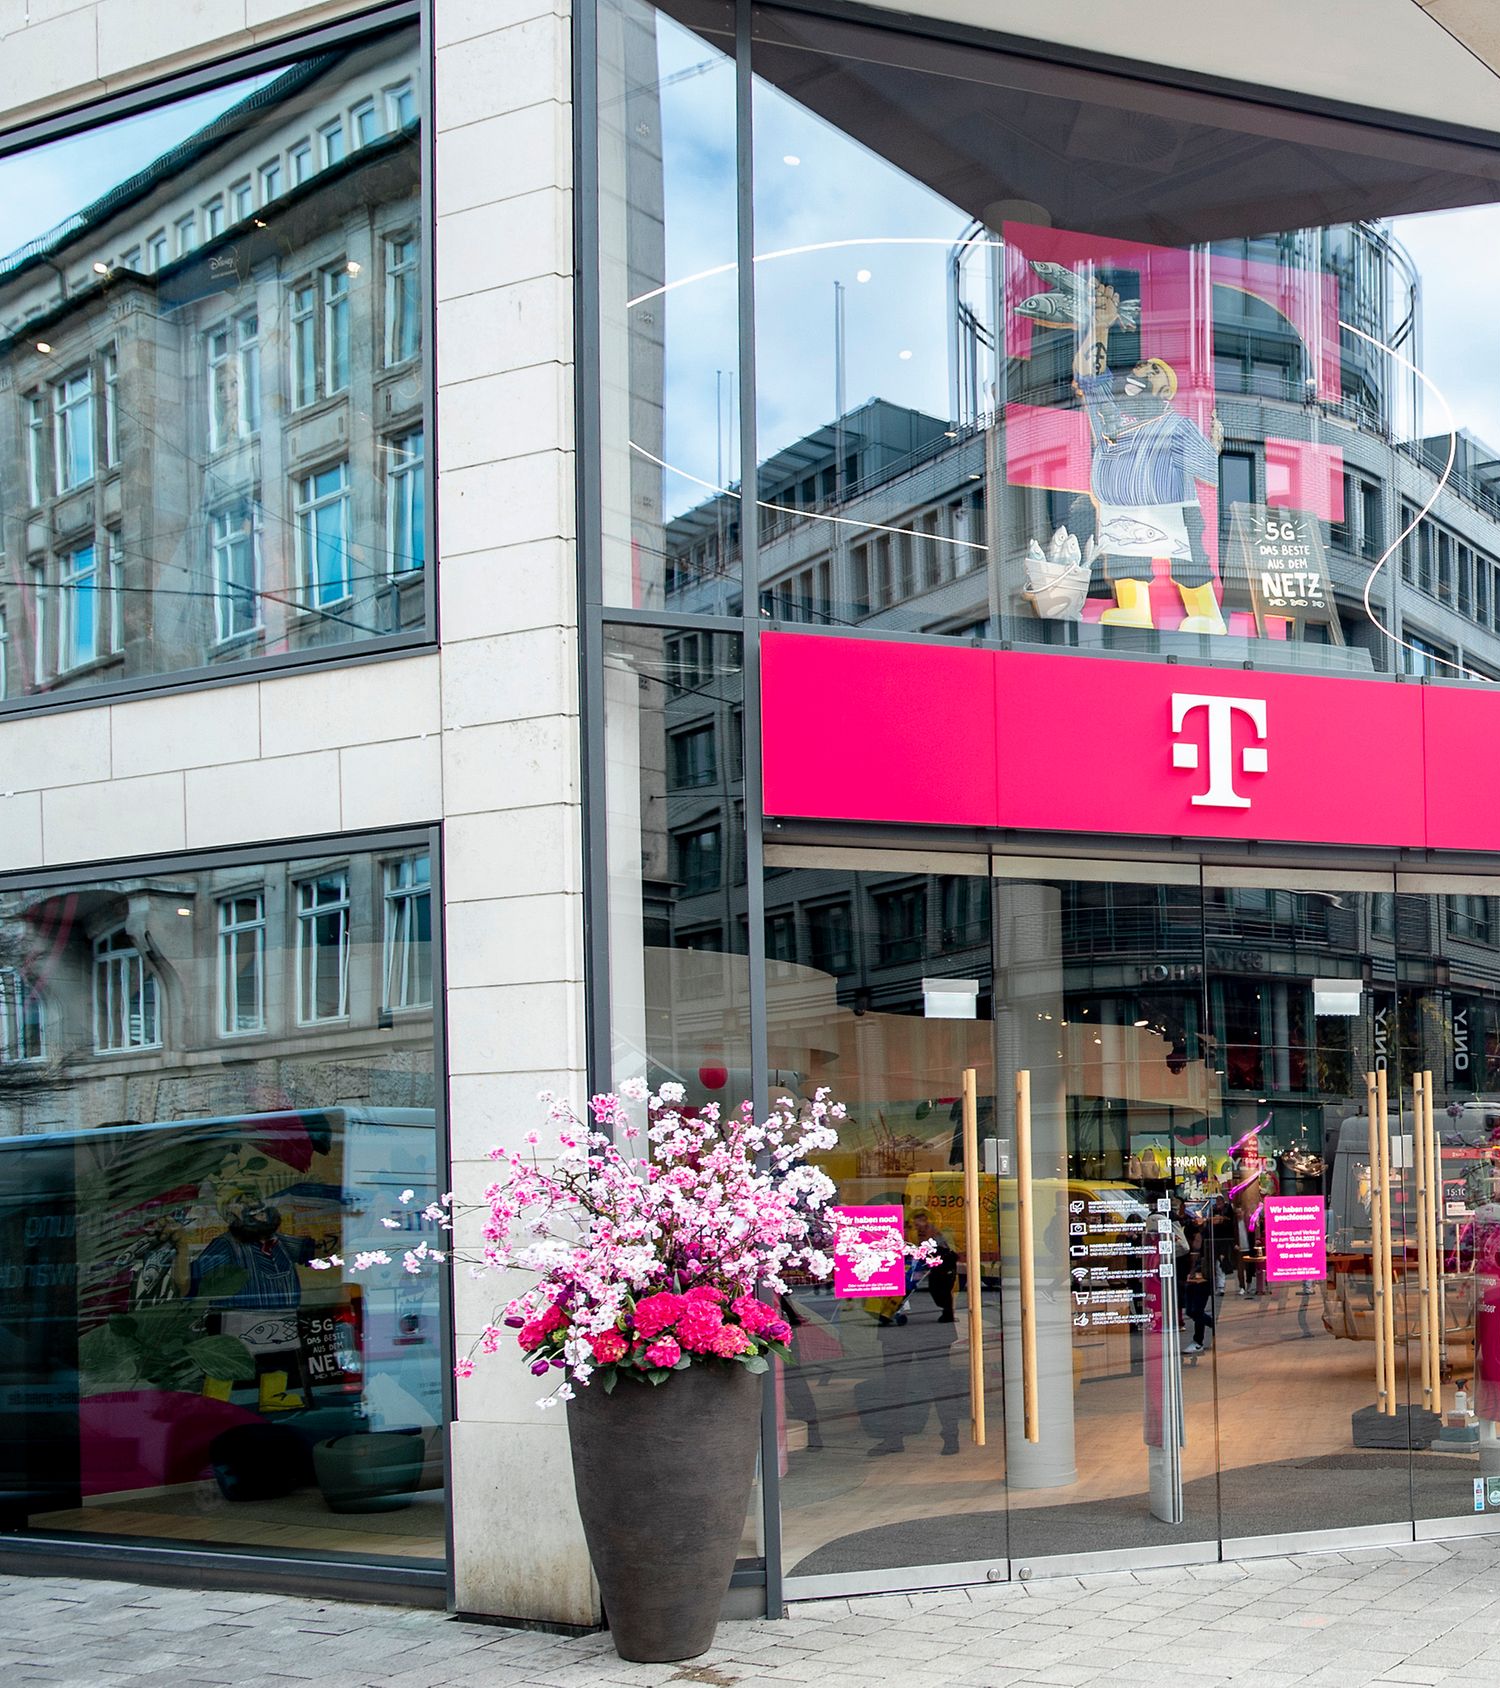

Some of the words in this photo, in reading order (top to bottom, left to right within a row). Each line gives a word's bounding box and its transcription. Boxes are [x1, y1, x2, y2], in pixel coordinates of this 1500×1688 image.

[1264, 521, 1296, 541] 5G
[1260, 545, 1279, 556] DAS
[1281, 545, 1311, 556] BESTE
[1267, 558, 1285, 570] AUS
[1288, 558, 1308, 569] DEM
[1261, 572, 1323, 598] NETZ
[1171, 692, 1268, 808] T
[1283, 1205, 1303, 1213] haben
[854, 1216, 878, 1224] haben
[879, 1215, 898, 1223] noch
[310, 1318, 334, 1333] 5G
[323, 1332, 346, 1342] BESTE
[313, 1345, 326, 1353] AUS
